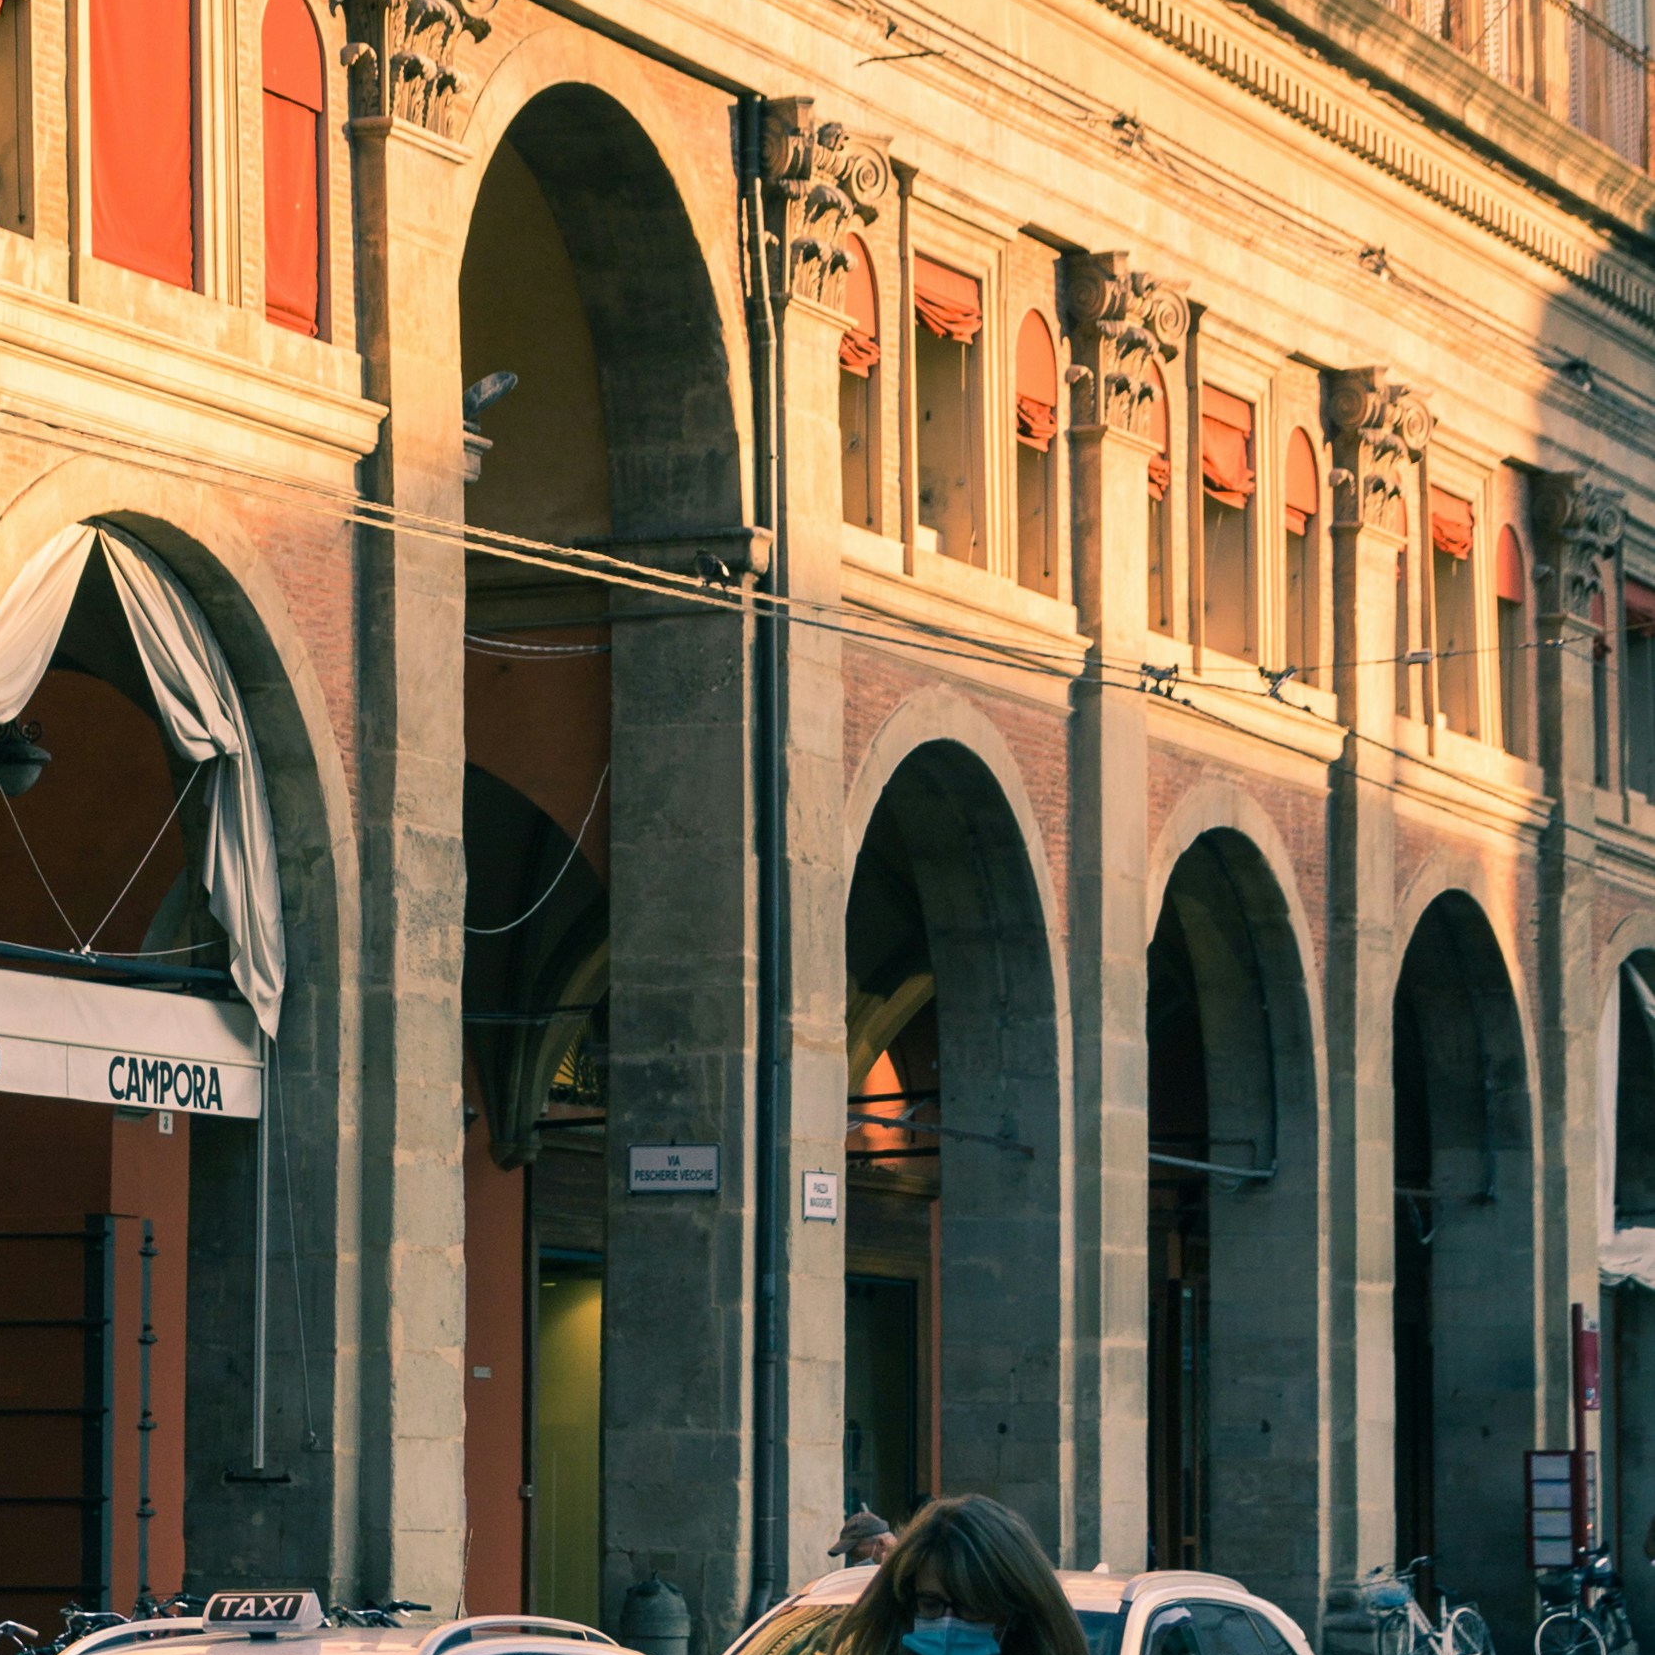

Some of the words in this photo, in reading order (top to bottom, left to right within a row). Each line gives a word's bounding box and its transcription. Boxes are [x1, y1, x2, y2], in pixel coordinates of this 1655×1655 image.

[108, 1055, 224, 1111] CAMPORA
[667, 1154, 681, 1167] VIA
[634, 1168, 678, 1182] PESCHERIE
[679, 1168, 713, 1182] VECCHIE
[220, 1596, 294, 1618] TAXI
